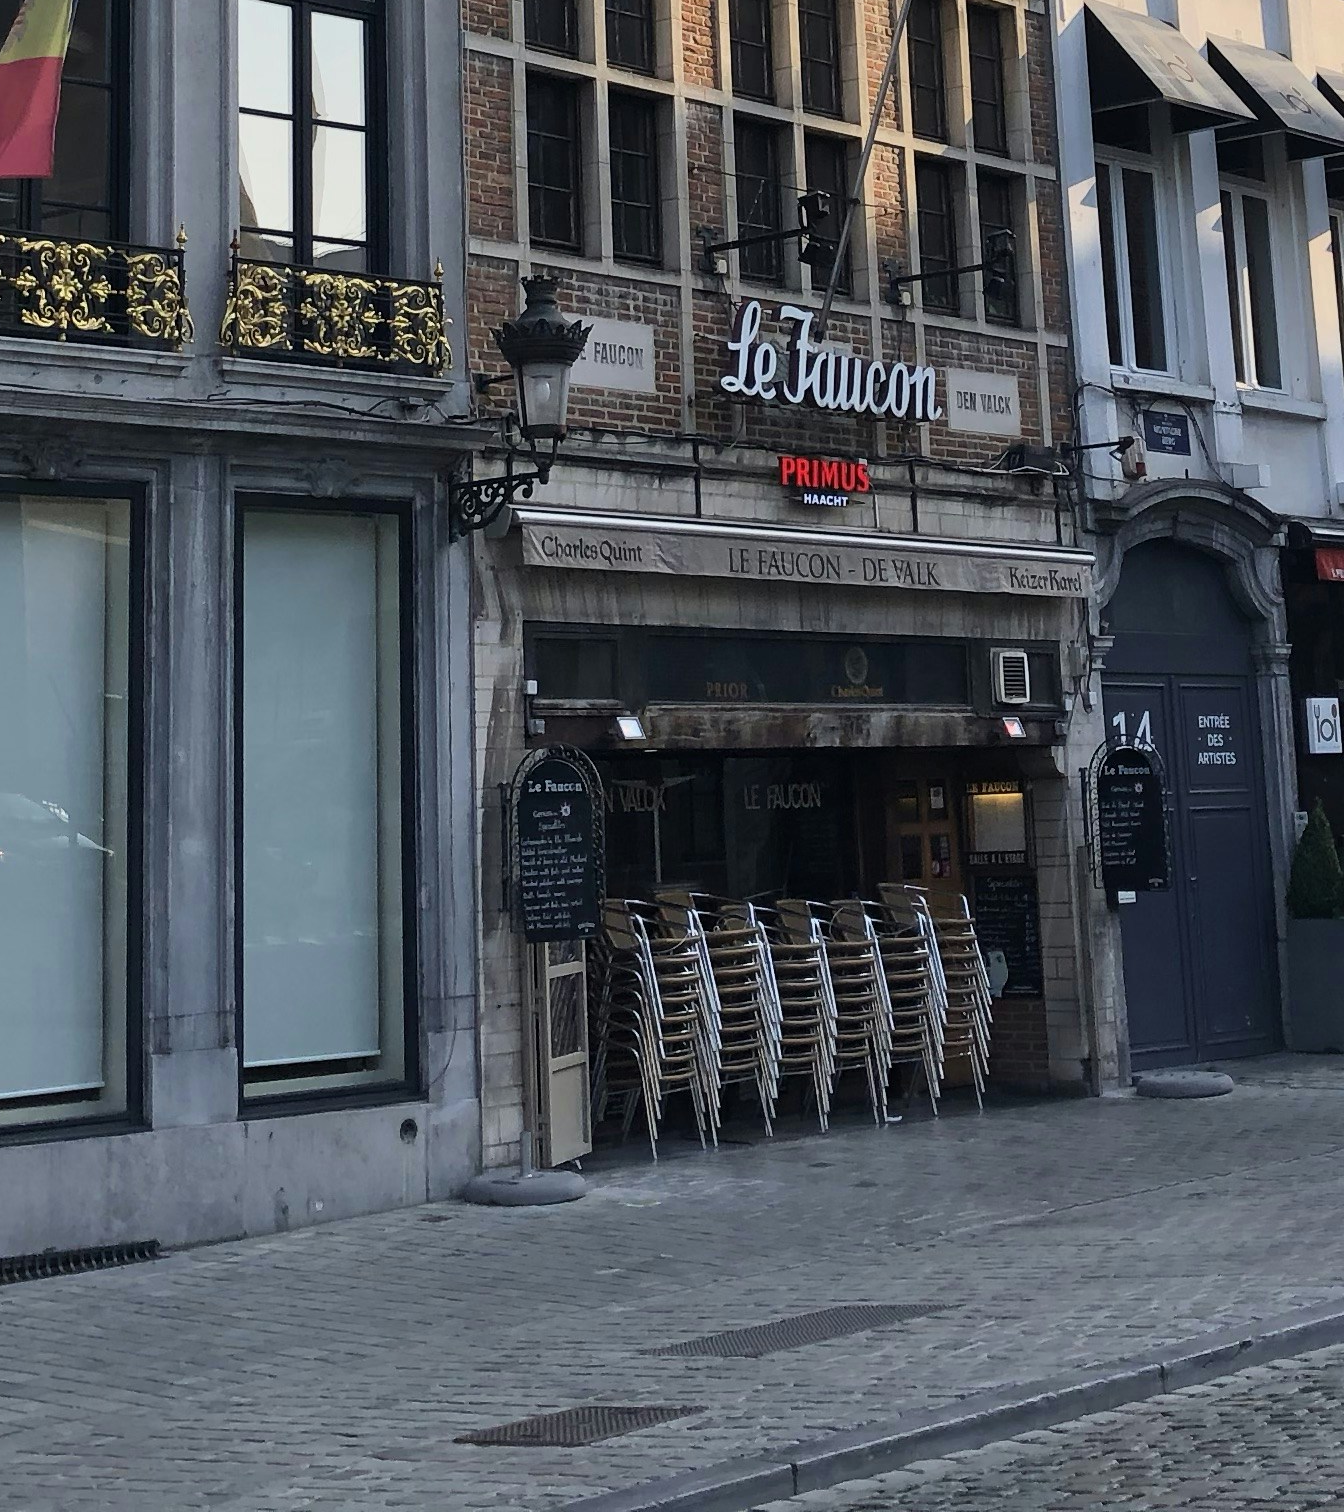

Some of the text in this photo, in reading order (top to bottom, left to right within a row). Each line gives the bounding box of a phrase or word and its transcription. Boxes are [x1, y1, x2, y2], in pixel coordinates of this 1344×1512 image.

[594, 342, 644, 370] FAUCON
[721, 300, 943, 421] Le Faucon
[956, 391, 1012, 415] DEN VALCK
[779, 456, 870, 493] PRIMUS
[803, 493, 848, 507] HAACHT
[728, 548, 750, 574] LE
[757, 550, 841, 580] FAUCON
[863, 558, 888, 583] DE
[892, 559, 941, 587] VALK
[706, 681, 748, 699] PRIOR
[1198, 713, 1230, 728] ENTRÉE
[1112, 710, 1155, 751] 14
[1207, 734, 1224, 746] DES
[1197, 752, 1236, 764] ARTISTES
[1104, 764, 1150, 775] Le Faucon
[528, 780, 583, 793] Le Faucon
[982, 781, 1019, 793] FAUCON
[744, 783, 821, 809] LE FAUCON
